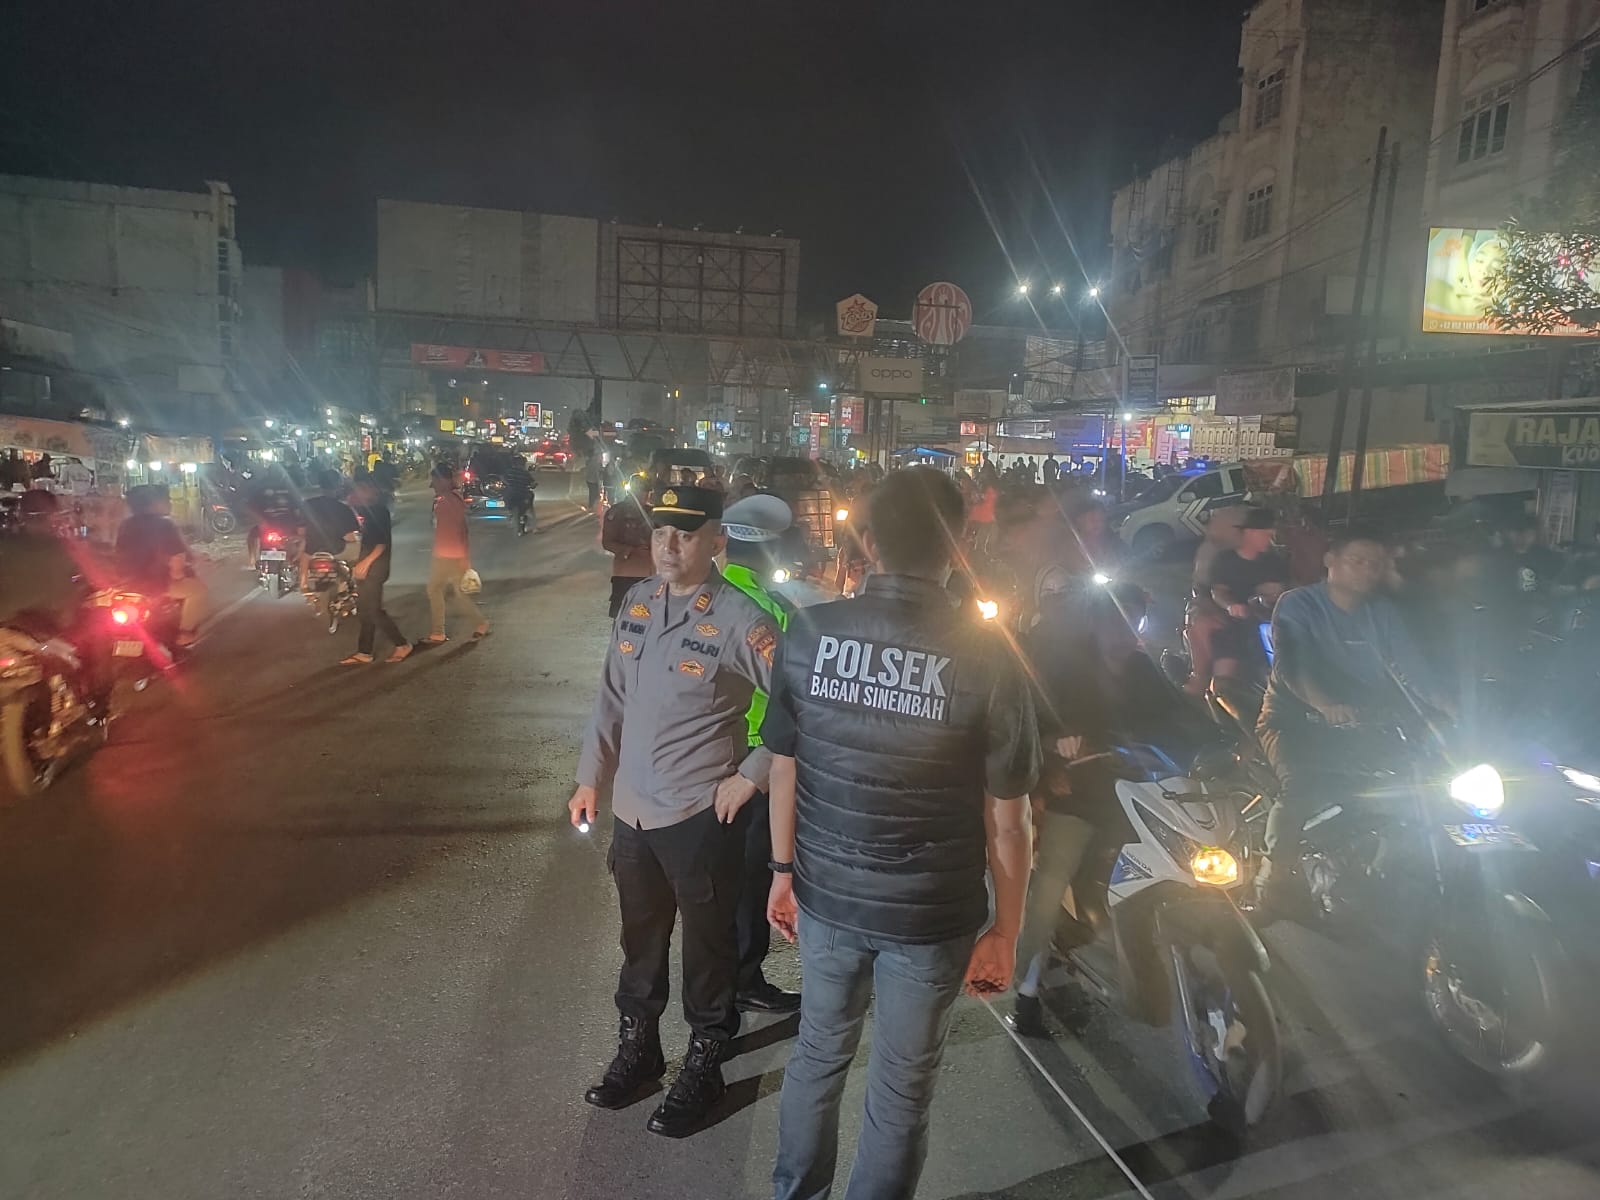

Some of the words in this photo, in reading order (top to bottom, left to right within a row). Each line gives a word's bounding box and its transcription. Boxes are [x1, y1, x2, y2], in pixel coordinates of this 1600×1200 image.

[1516, 417, 1600, 444] RAJA
[681, 638, 720, 658] POLRI
[815, 635, 951, 697] POLSEK
[810, 675, 860, 703] BAGAN
[863, 685, 945, 721] SINEMBAH
